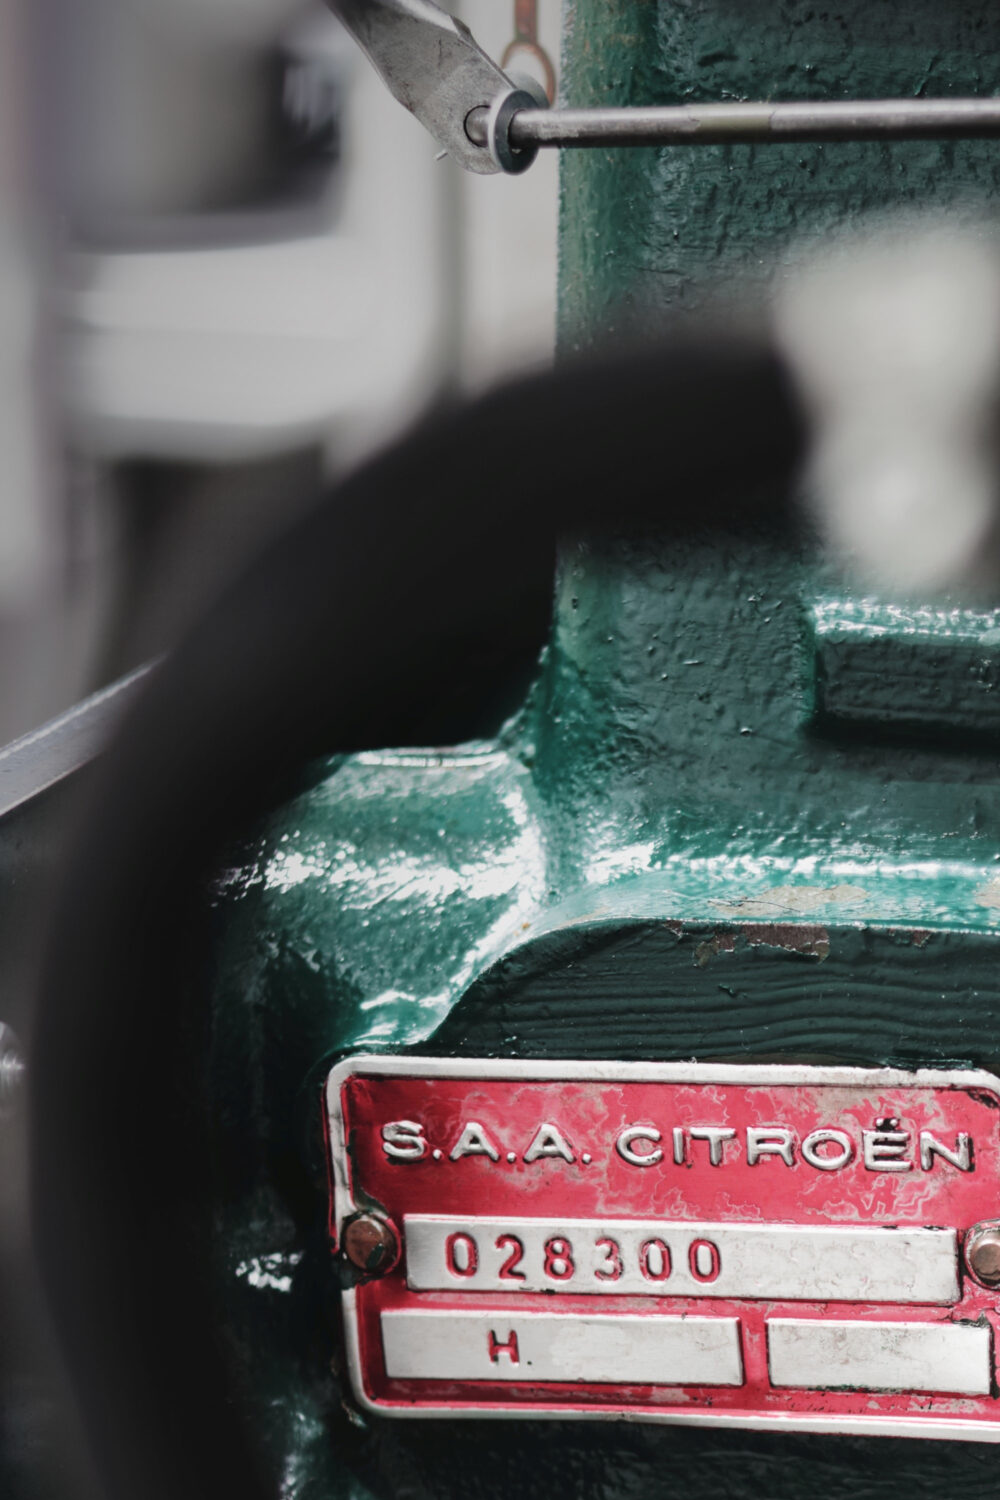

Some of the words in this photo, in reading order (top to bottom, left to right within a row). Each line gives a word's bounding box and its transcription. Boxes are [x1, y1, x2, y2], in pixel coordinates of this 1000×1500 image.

[381, 1120, 592, 1166] S.A.A.
[616, 1117, 976, 1173] CITROËN
[445, 1230, 722, 1285] 028300
